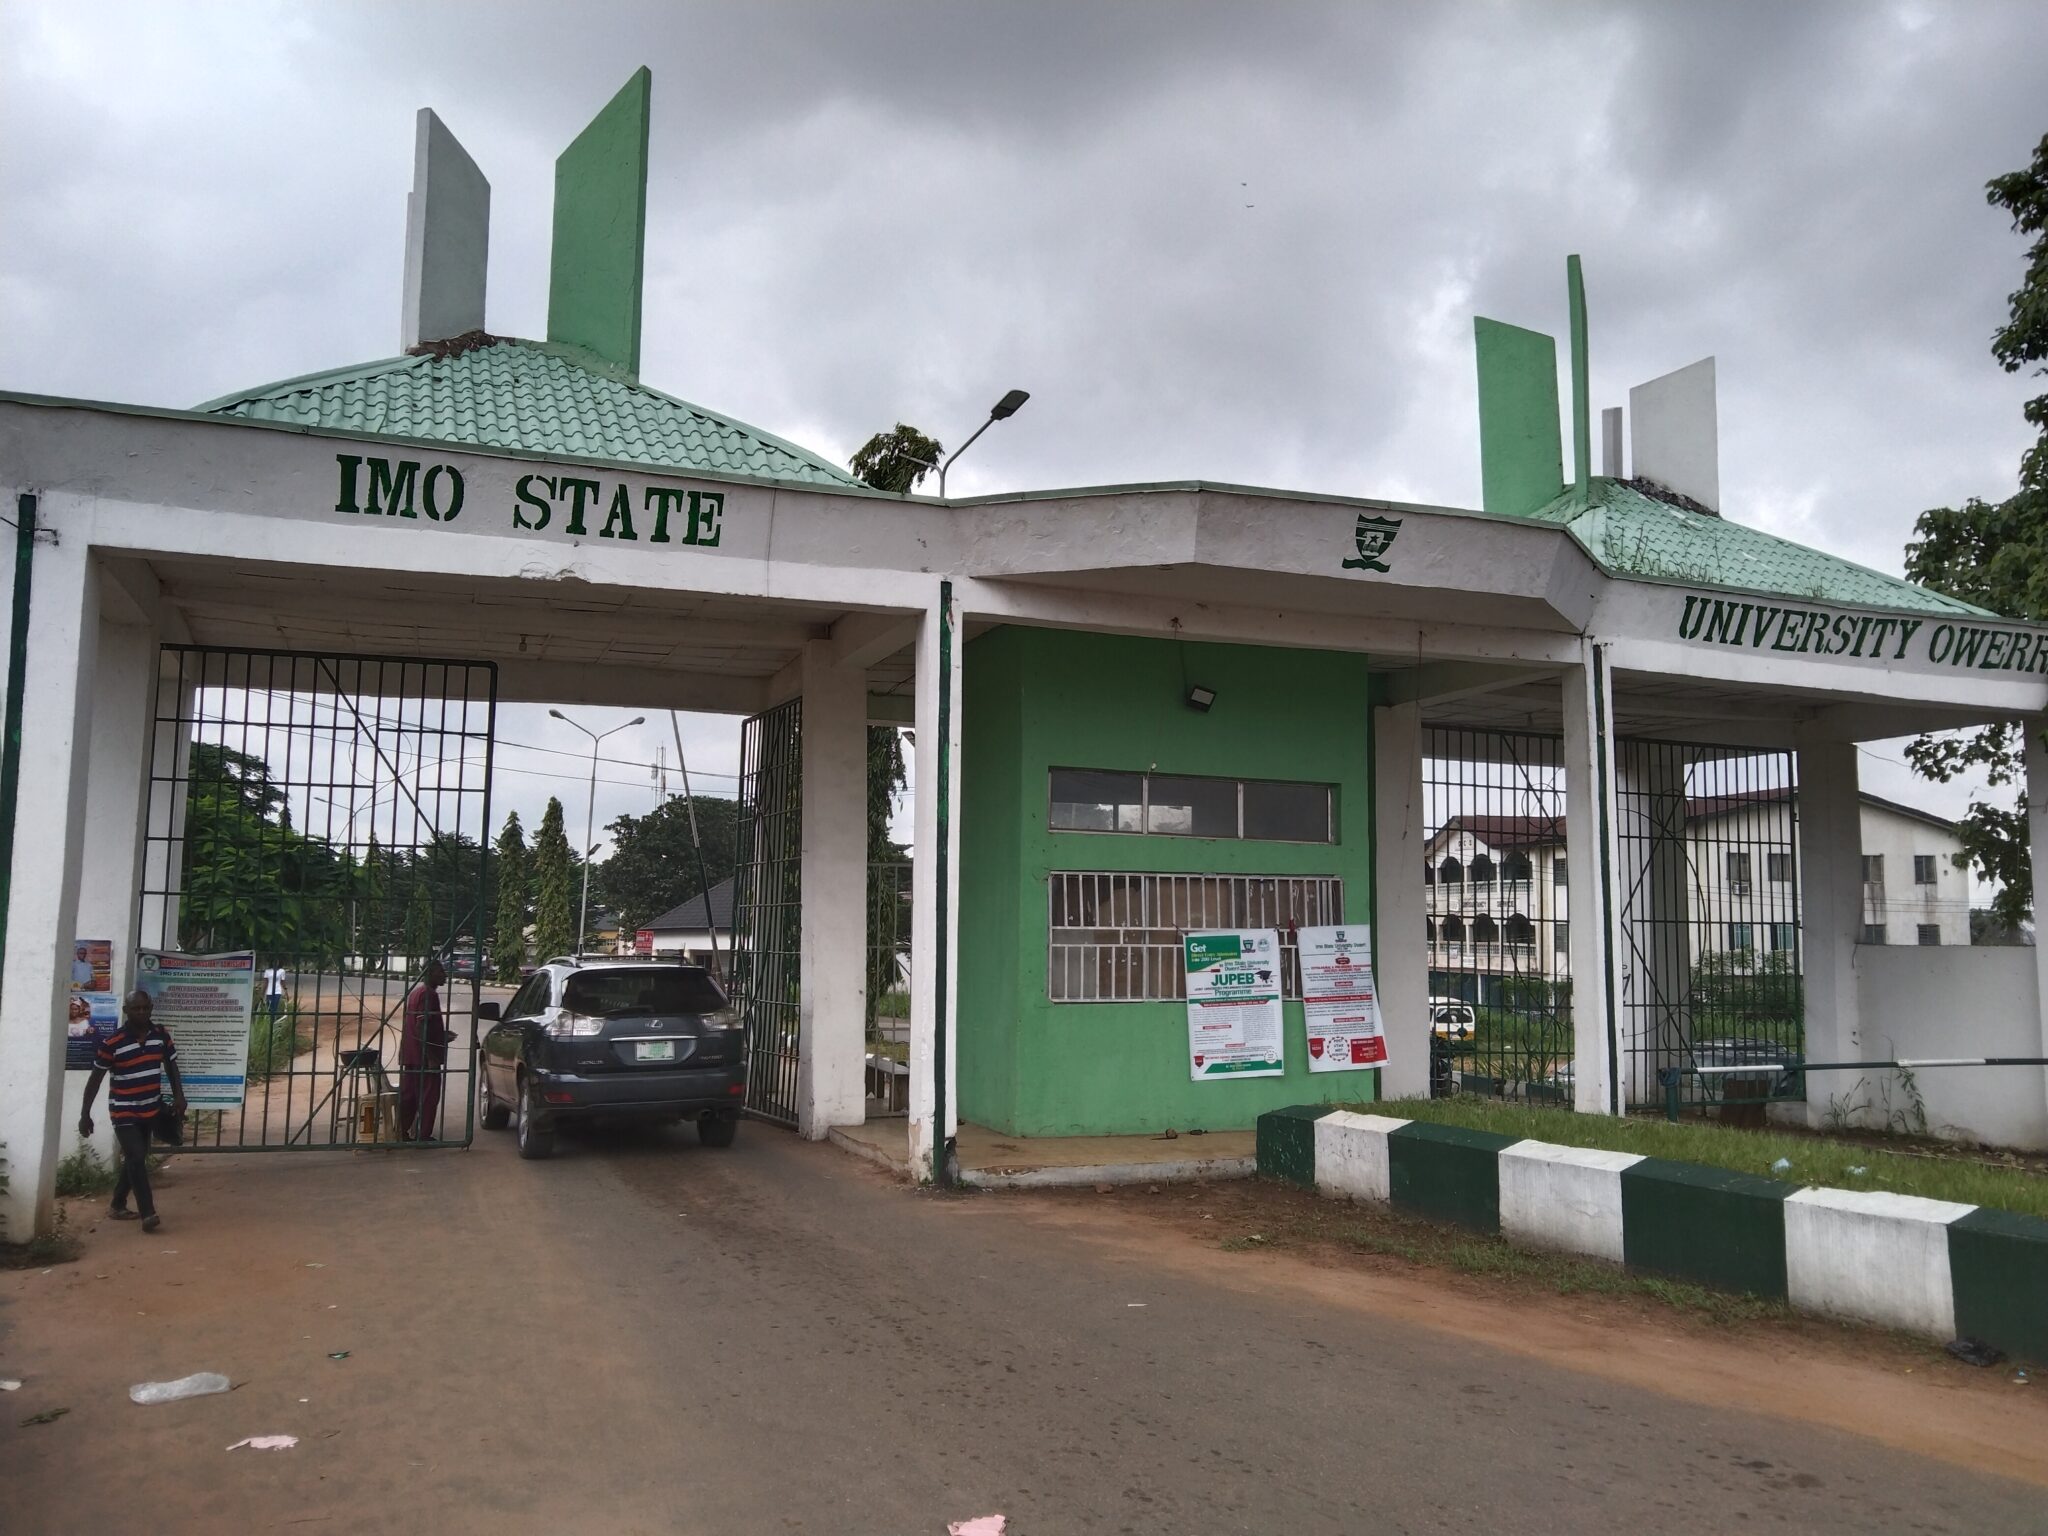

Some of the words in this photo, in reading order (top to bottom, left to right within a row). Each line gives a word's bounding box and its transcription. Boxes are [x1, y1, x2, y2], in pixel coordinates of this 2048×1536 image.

[335, 454, 465, 522] IMO
[512, 474, 725, 547] STATE
[1678, 595, 1922, 660] UNIVERSITY
[1928, 624, 2048, 676] OWERR
[1190, 943, 1207, 953] Get
[1211, 973, 1255, 986] JUPEB
[1214, 989, 1252, 997] Programme
